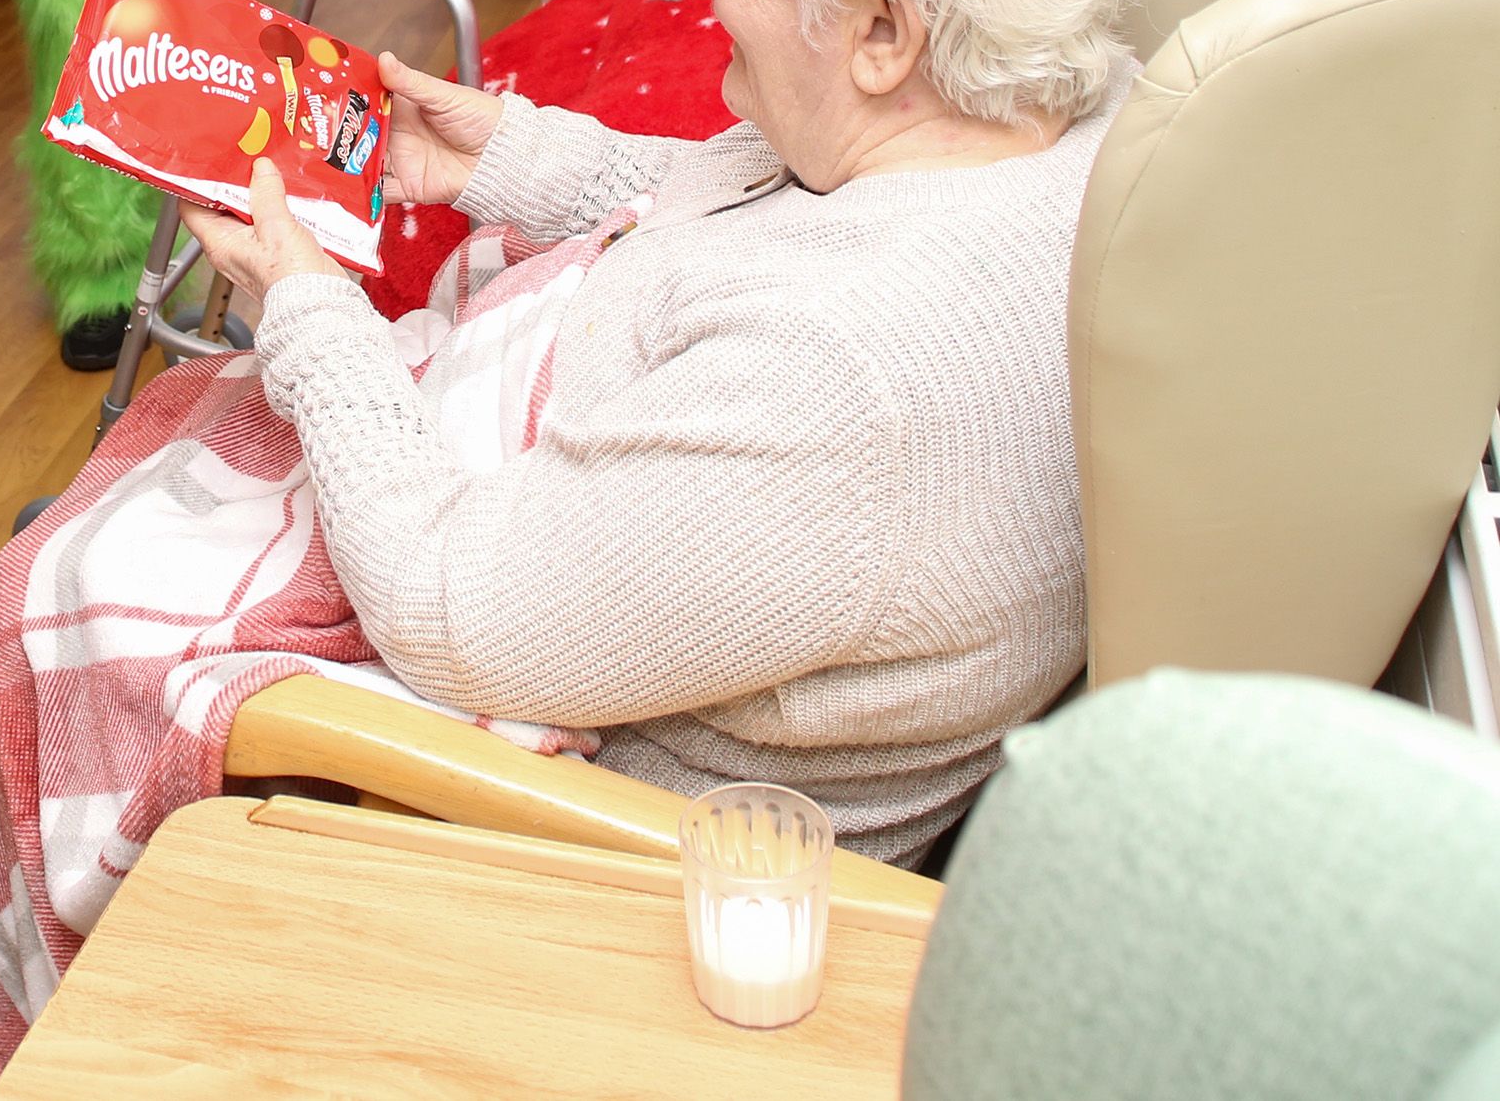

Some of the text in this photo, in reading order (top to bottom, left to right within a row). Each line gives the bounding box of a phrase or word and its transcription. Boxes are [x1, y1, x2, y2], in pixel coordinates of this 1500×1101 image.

[89, 32, 256, 102] Maltesers
[202, 85, 250, 103] & FRIENDS
[337, 105, 361, 164] Mars
